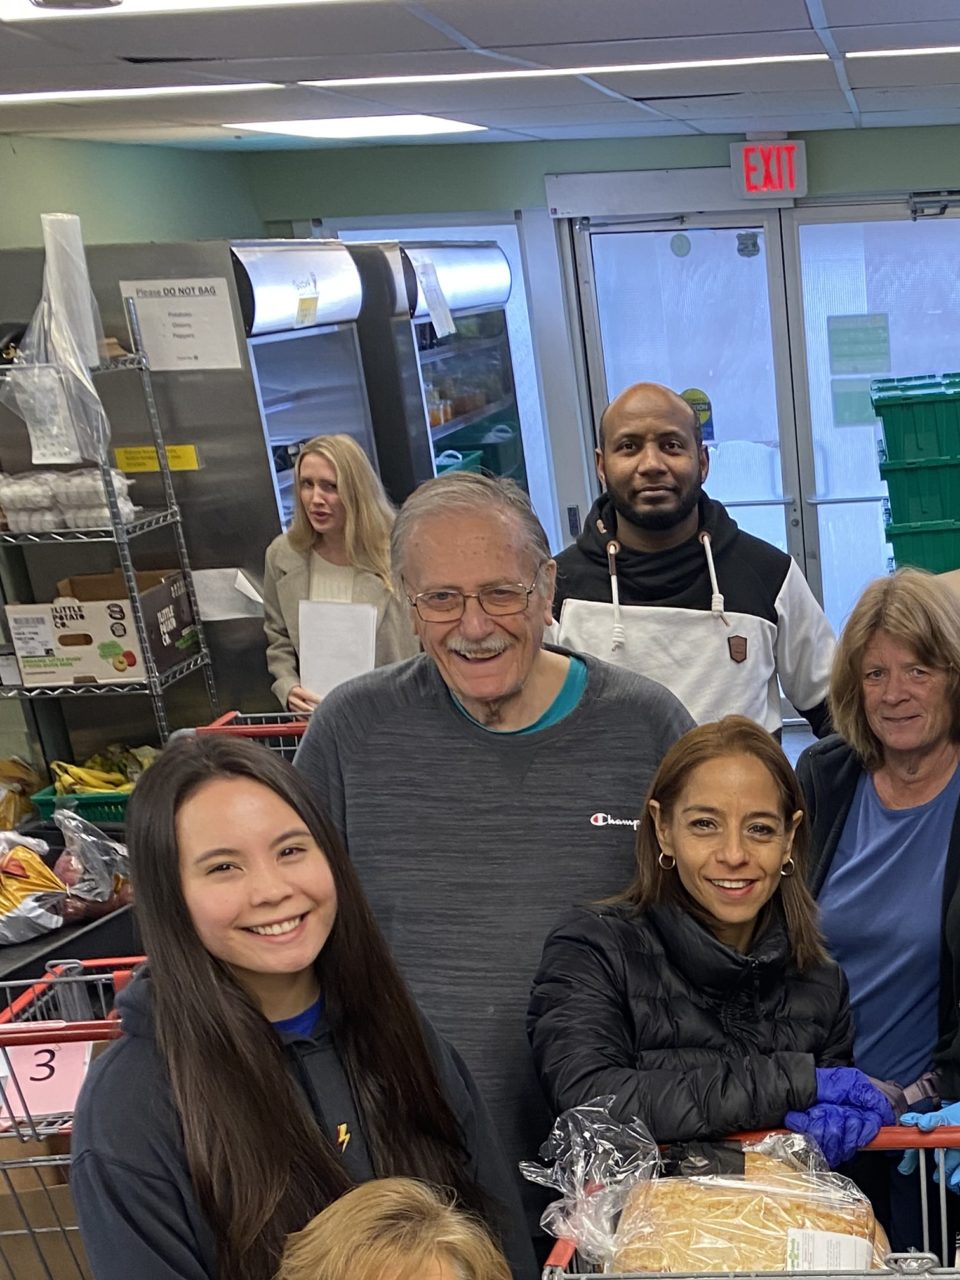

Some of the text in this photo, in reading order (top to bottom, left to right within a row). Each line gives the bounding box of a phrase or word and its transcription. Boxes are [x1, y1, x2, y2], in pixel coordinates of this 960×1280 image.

[743, 145, 796, 191] EXIT
[163, 287, 176, 297] DO
[178, 286, 196, 297] NOT
[198, 286, 216, 296] BAG
[54, 605, 82, 614] LITTLE
[52, 613, 85, 622] POTATO
[590, 812, 640, 831] Champ
[29, 1048, 56, 1082] 3
